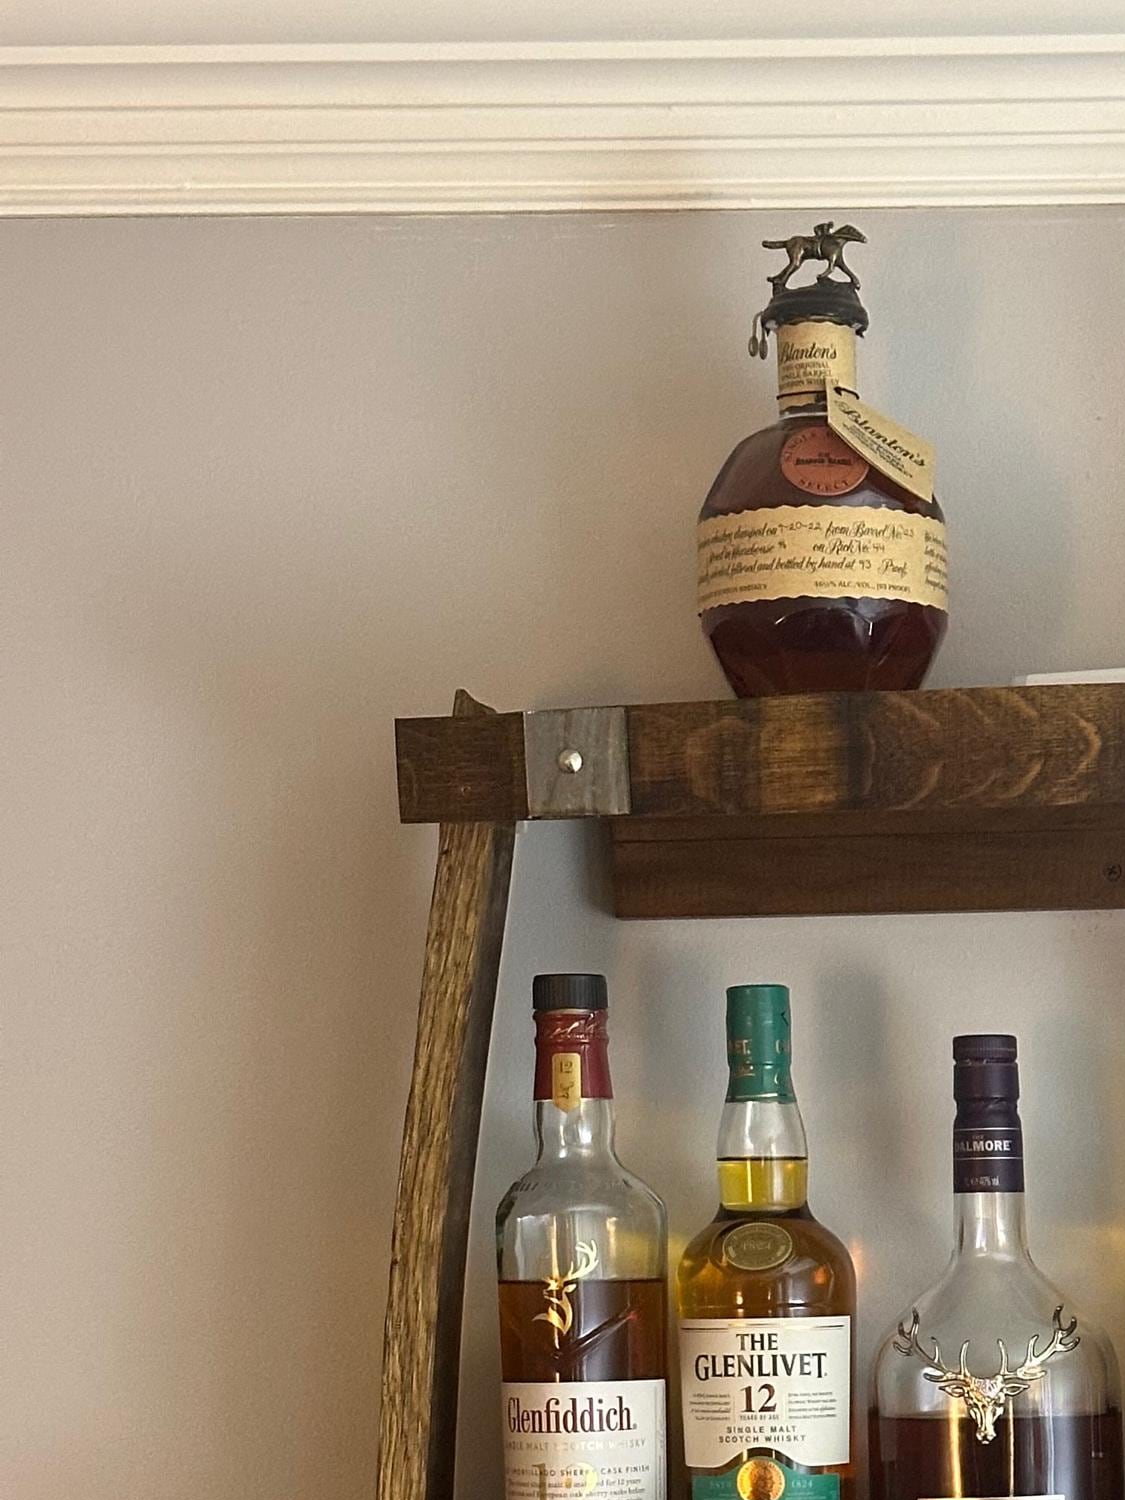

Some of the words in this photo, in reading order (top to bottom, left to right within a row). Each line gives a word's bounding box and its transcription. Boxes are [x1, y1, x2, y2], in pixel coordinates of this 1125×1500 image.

[780, 342, 837, 362] Blanton's
[833, 400, 926, 467] Blanton's
[776, 557, 806, 570] bottled
[806, 557, 818, 573] by
[818, 557, 845, 570] hand
[736, 1333, 778, 1351] THE
[695, 1352, 827, 1381] GLENLIVET
[739, 1383, 778, 1413] 12
[508, 1396, 634, 1434] Glenfiddich
[718, 1435, 759, 1443] SCOTCH
[764, 1434, 806, 1442] WHISKY
[726, 1425, 765, 1434] SINGLE
[770, 1425, 797, 1433] MALT
[601, 1467, 622, 1475] CASK
[626, 1465, 650, 1473] FINISH
